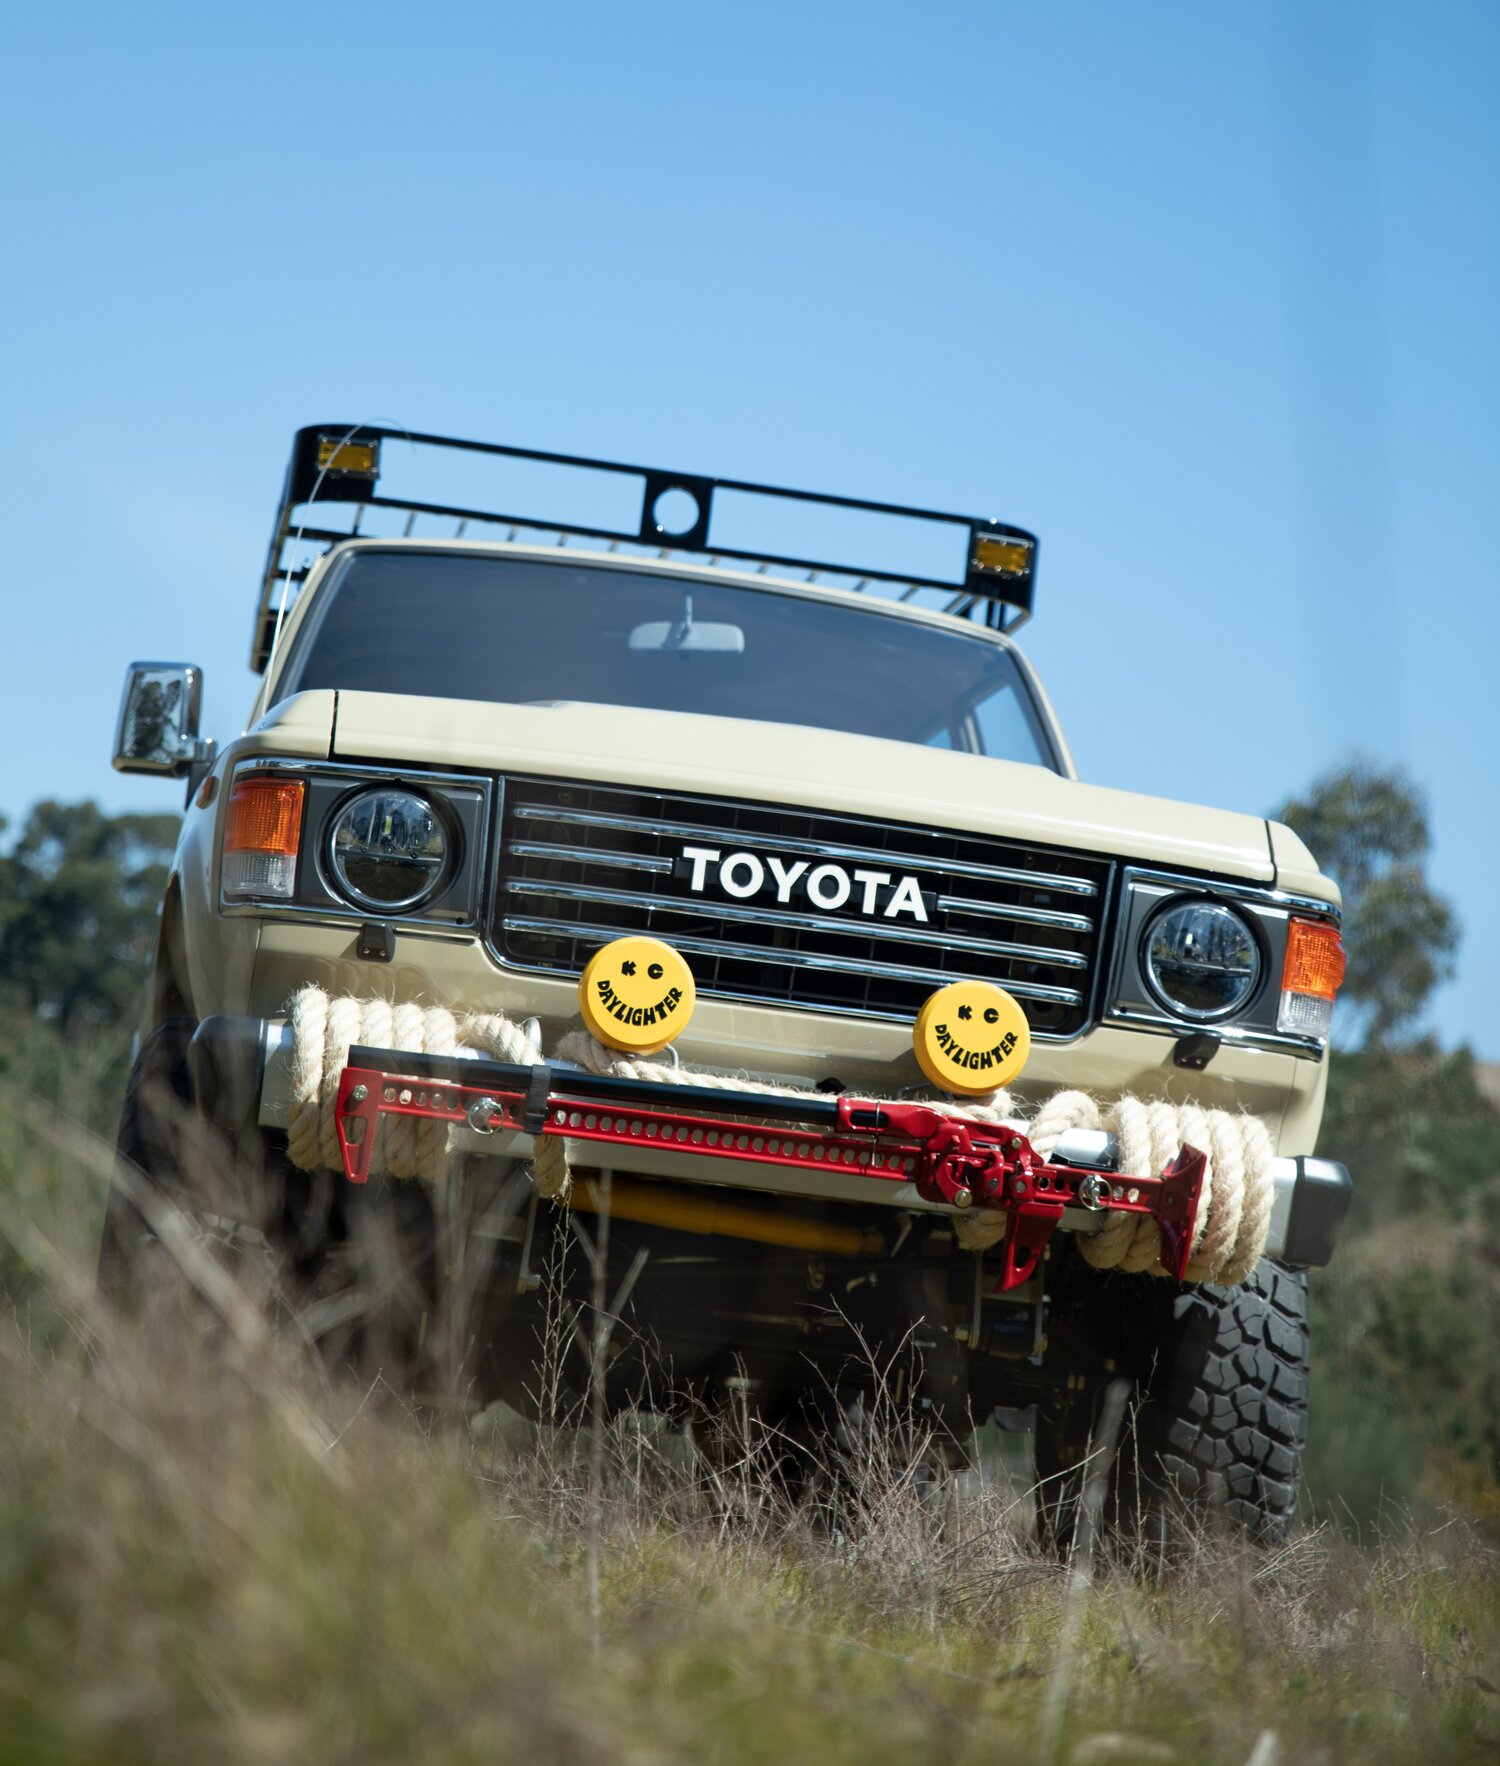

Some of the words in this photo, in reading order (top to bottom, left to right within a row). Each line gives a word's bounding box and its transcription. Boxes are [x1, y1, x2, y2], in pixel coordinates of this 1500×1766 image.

[683, 846, 929, 922] TOYOTA
[597, 980, 683, 1026] DAYLIGHTER
[935, 1024, 1018, 1070] DAYLIGHTER
